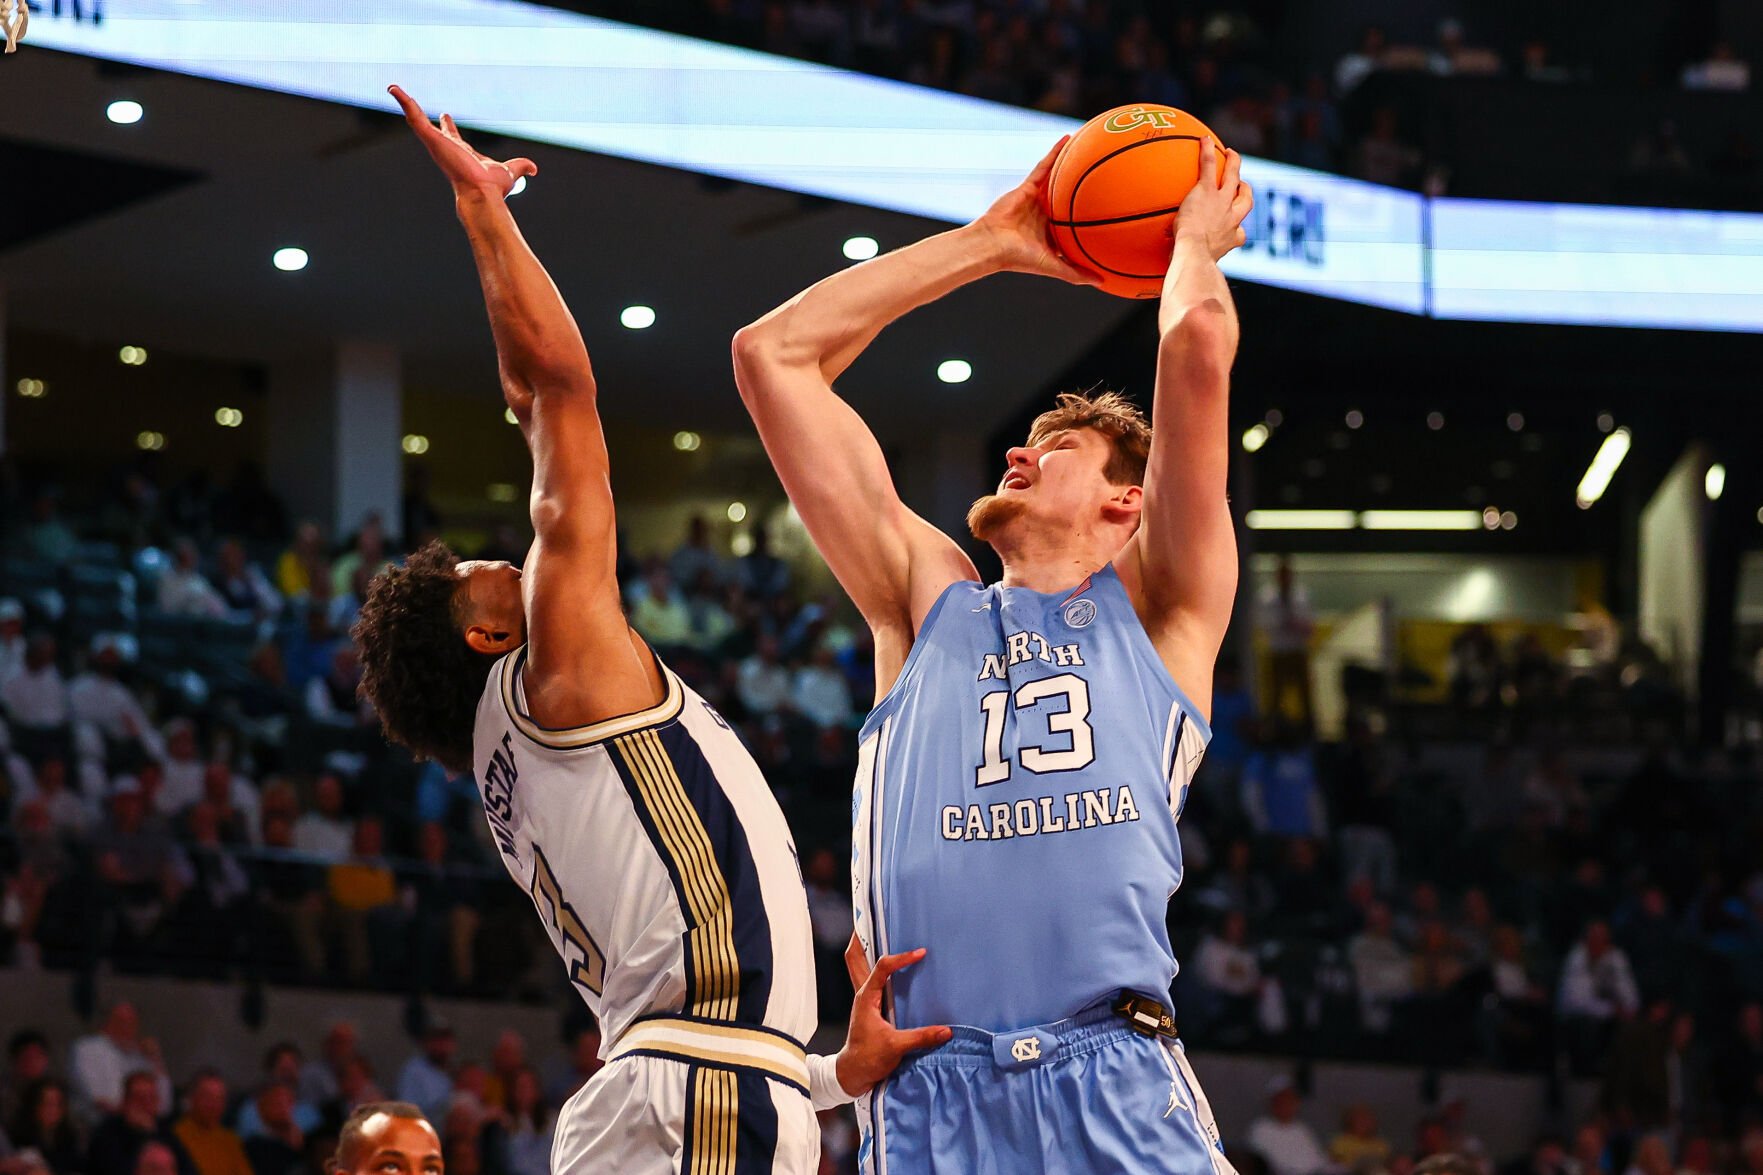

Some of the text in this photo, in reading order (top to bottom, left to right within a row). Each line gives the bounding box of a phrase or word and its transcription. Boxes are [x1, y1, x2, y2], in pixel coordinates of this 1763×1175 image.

[1104, 107, 1176, 133] GT
[978, 630, 1085, 681] NRTH
[975, 672, 1095, 788] 13
[941, 785, 1140, 841] CAROLINA
[530, 841, 606, 999] 3
